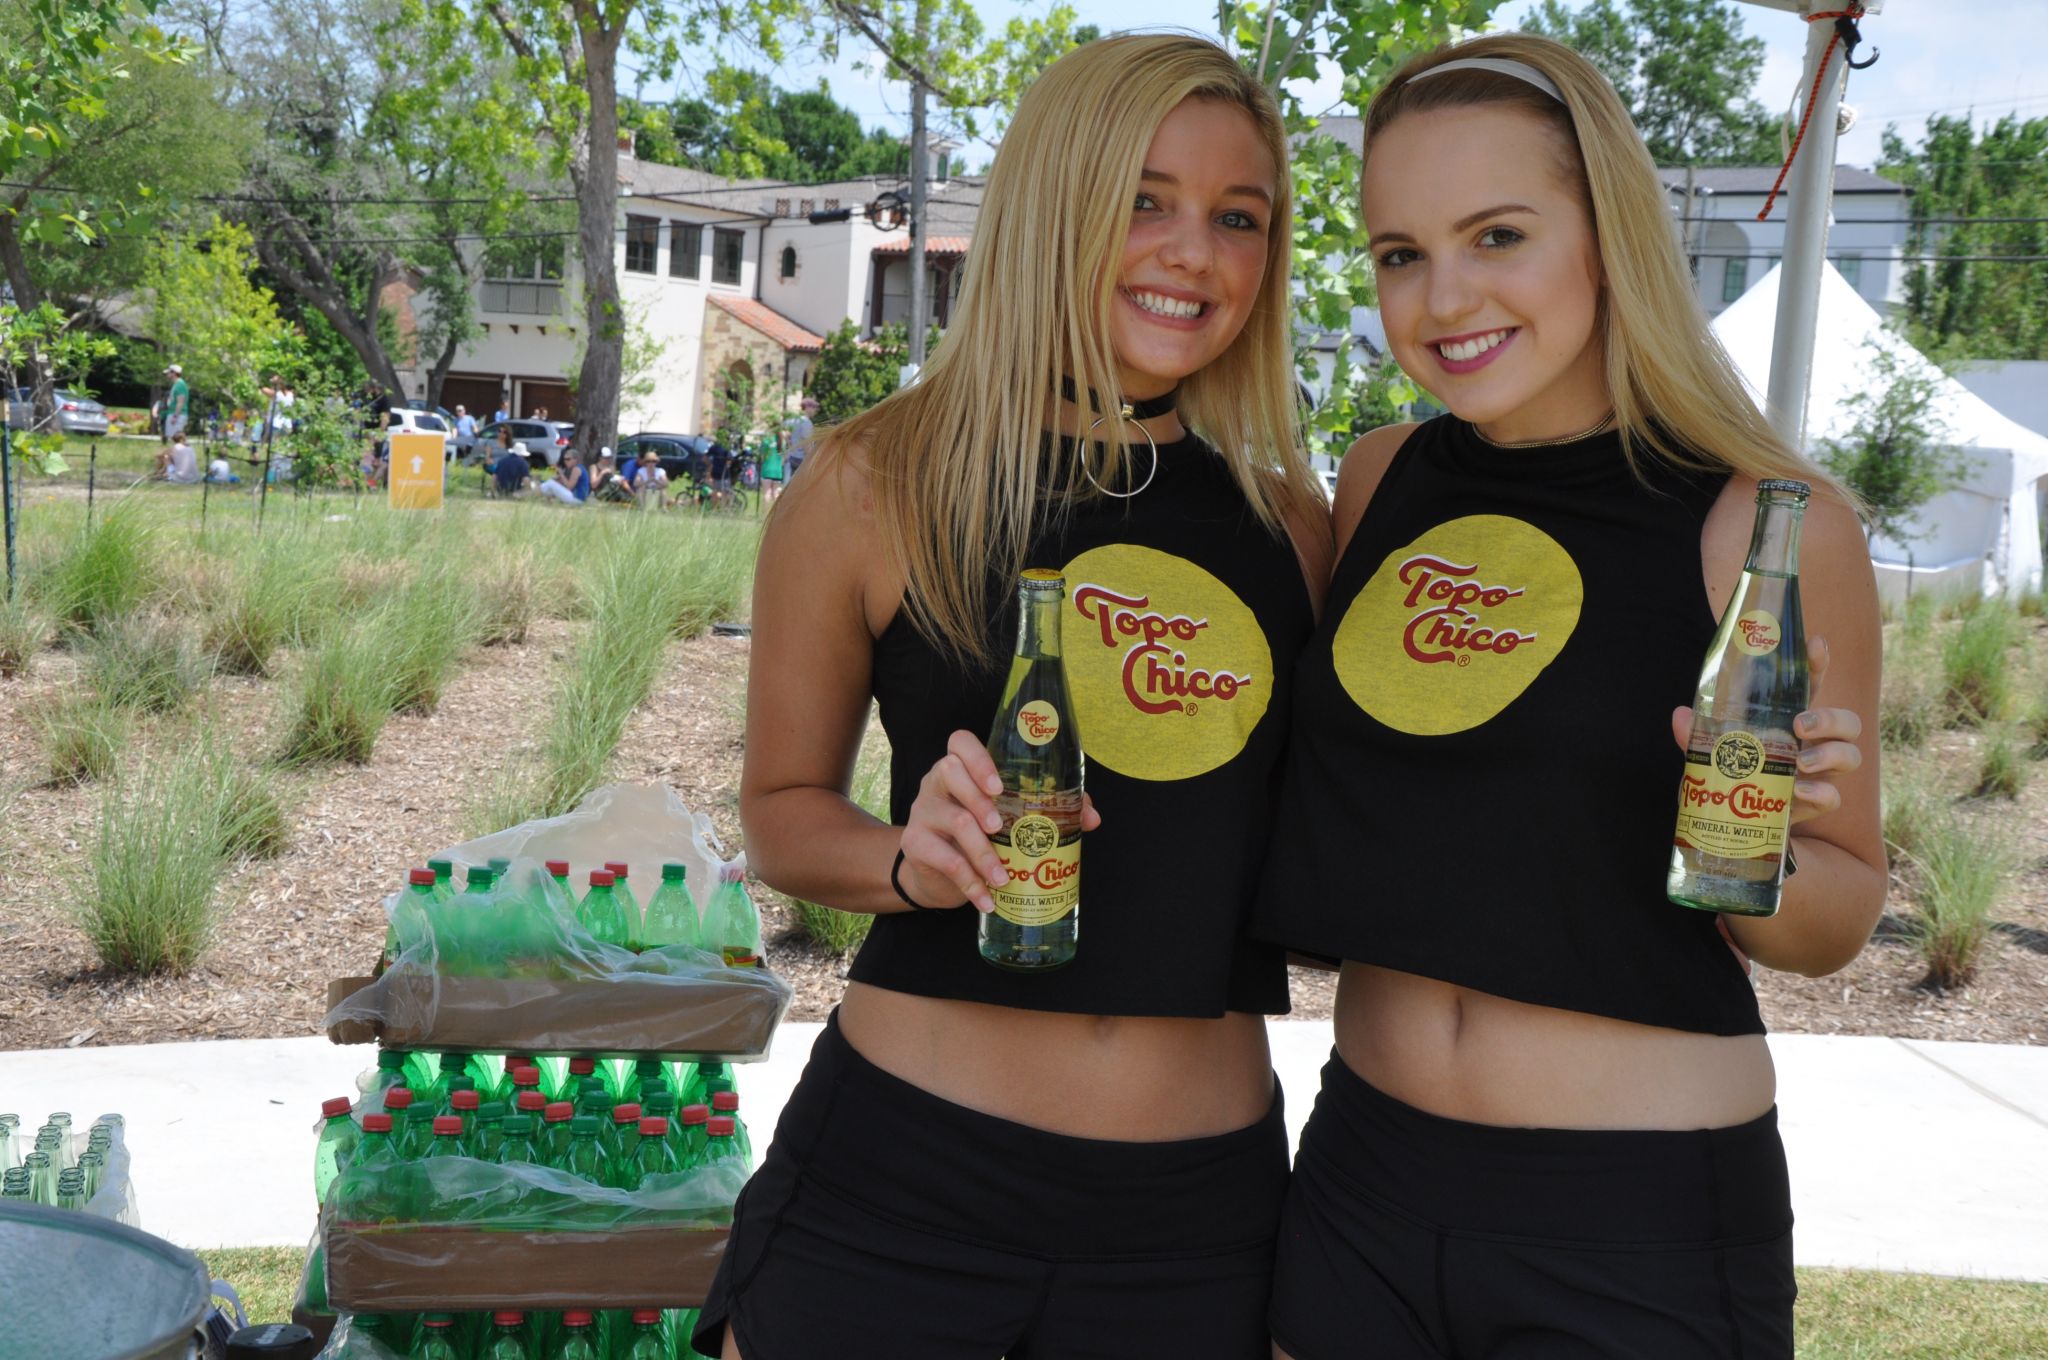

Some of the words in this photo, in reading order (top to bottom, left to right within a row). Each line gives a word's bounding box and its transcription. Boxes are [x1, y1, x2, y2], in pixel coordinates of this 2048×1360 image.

[1399, 554, 1525, 609] Topo
[1073, 583, 1208, 648] Topo
[1738, 619, 1771, 634] Topo
[1403, 605, 1537, 664] Chico
[1746, 631, 1778, 647] Chico
[1122, 641, 1251, 714] Chico
[1020, 711, 1050, 726] Topo
[1029, 723, 1057, 738] Chico
[1682, 774, 1728, 808] Topo
[1728, 783, 1786, 819] Chico
[1691, 820, 1730, 835] MINERAL
[1734, 827, 1765, 839] WATER
[1034, 858, 1079, 890] Chico
[999, 893, 1036, 906] MINERAL
[1039, 894, 1065, 906] WATER
